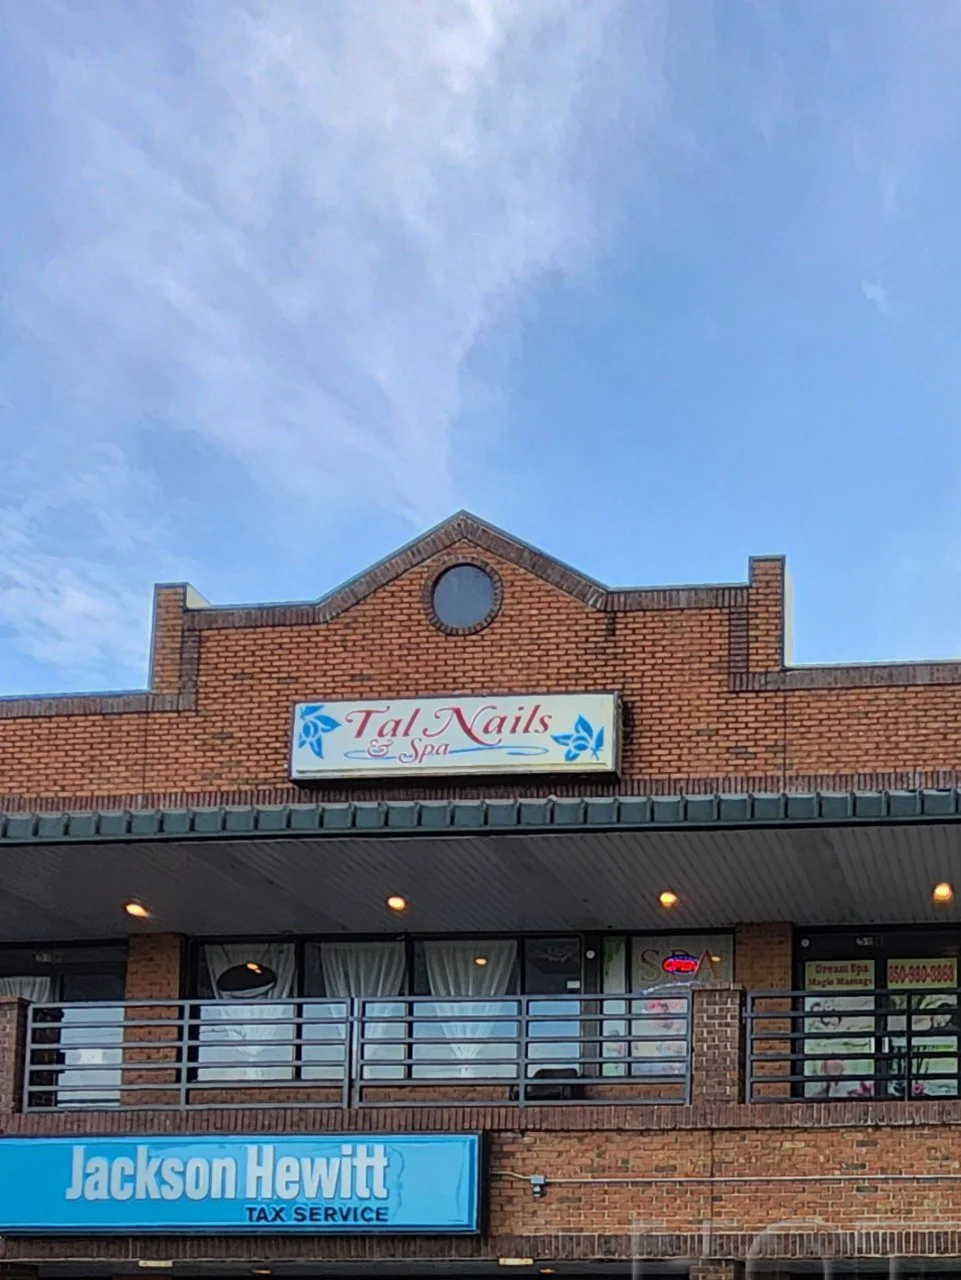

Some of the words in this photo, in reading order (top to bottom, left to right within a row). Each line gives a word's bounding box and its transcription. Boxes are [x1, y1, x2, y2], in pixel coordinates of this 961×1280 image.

[345, 705, 422, 739] Tal
[422, 704, 553, 747] Nails
[366, 739, 394, 758] &
[398, 737, 450, 764] Spa
[851, 963, 869, 976] Spa
[65, 1145, 238, 1201] Jackson
[245, 1144, 389, 1200] Hewitt
[245, 1206, 286, 1223] TAX
[292, 1206, 390, 1222] SERVICE
